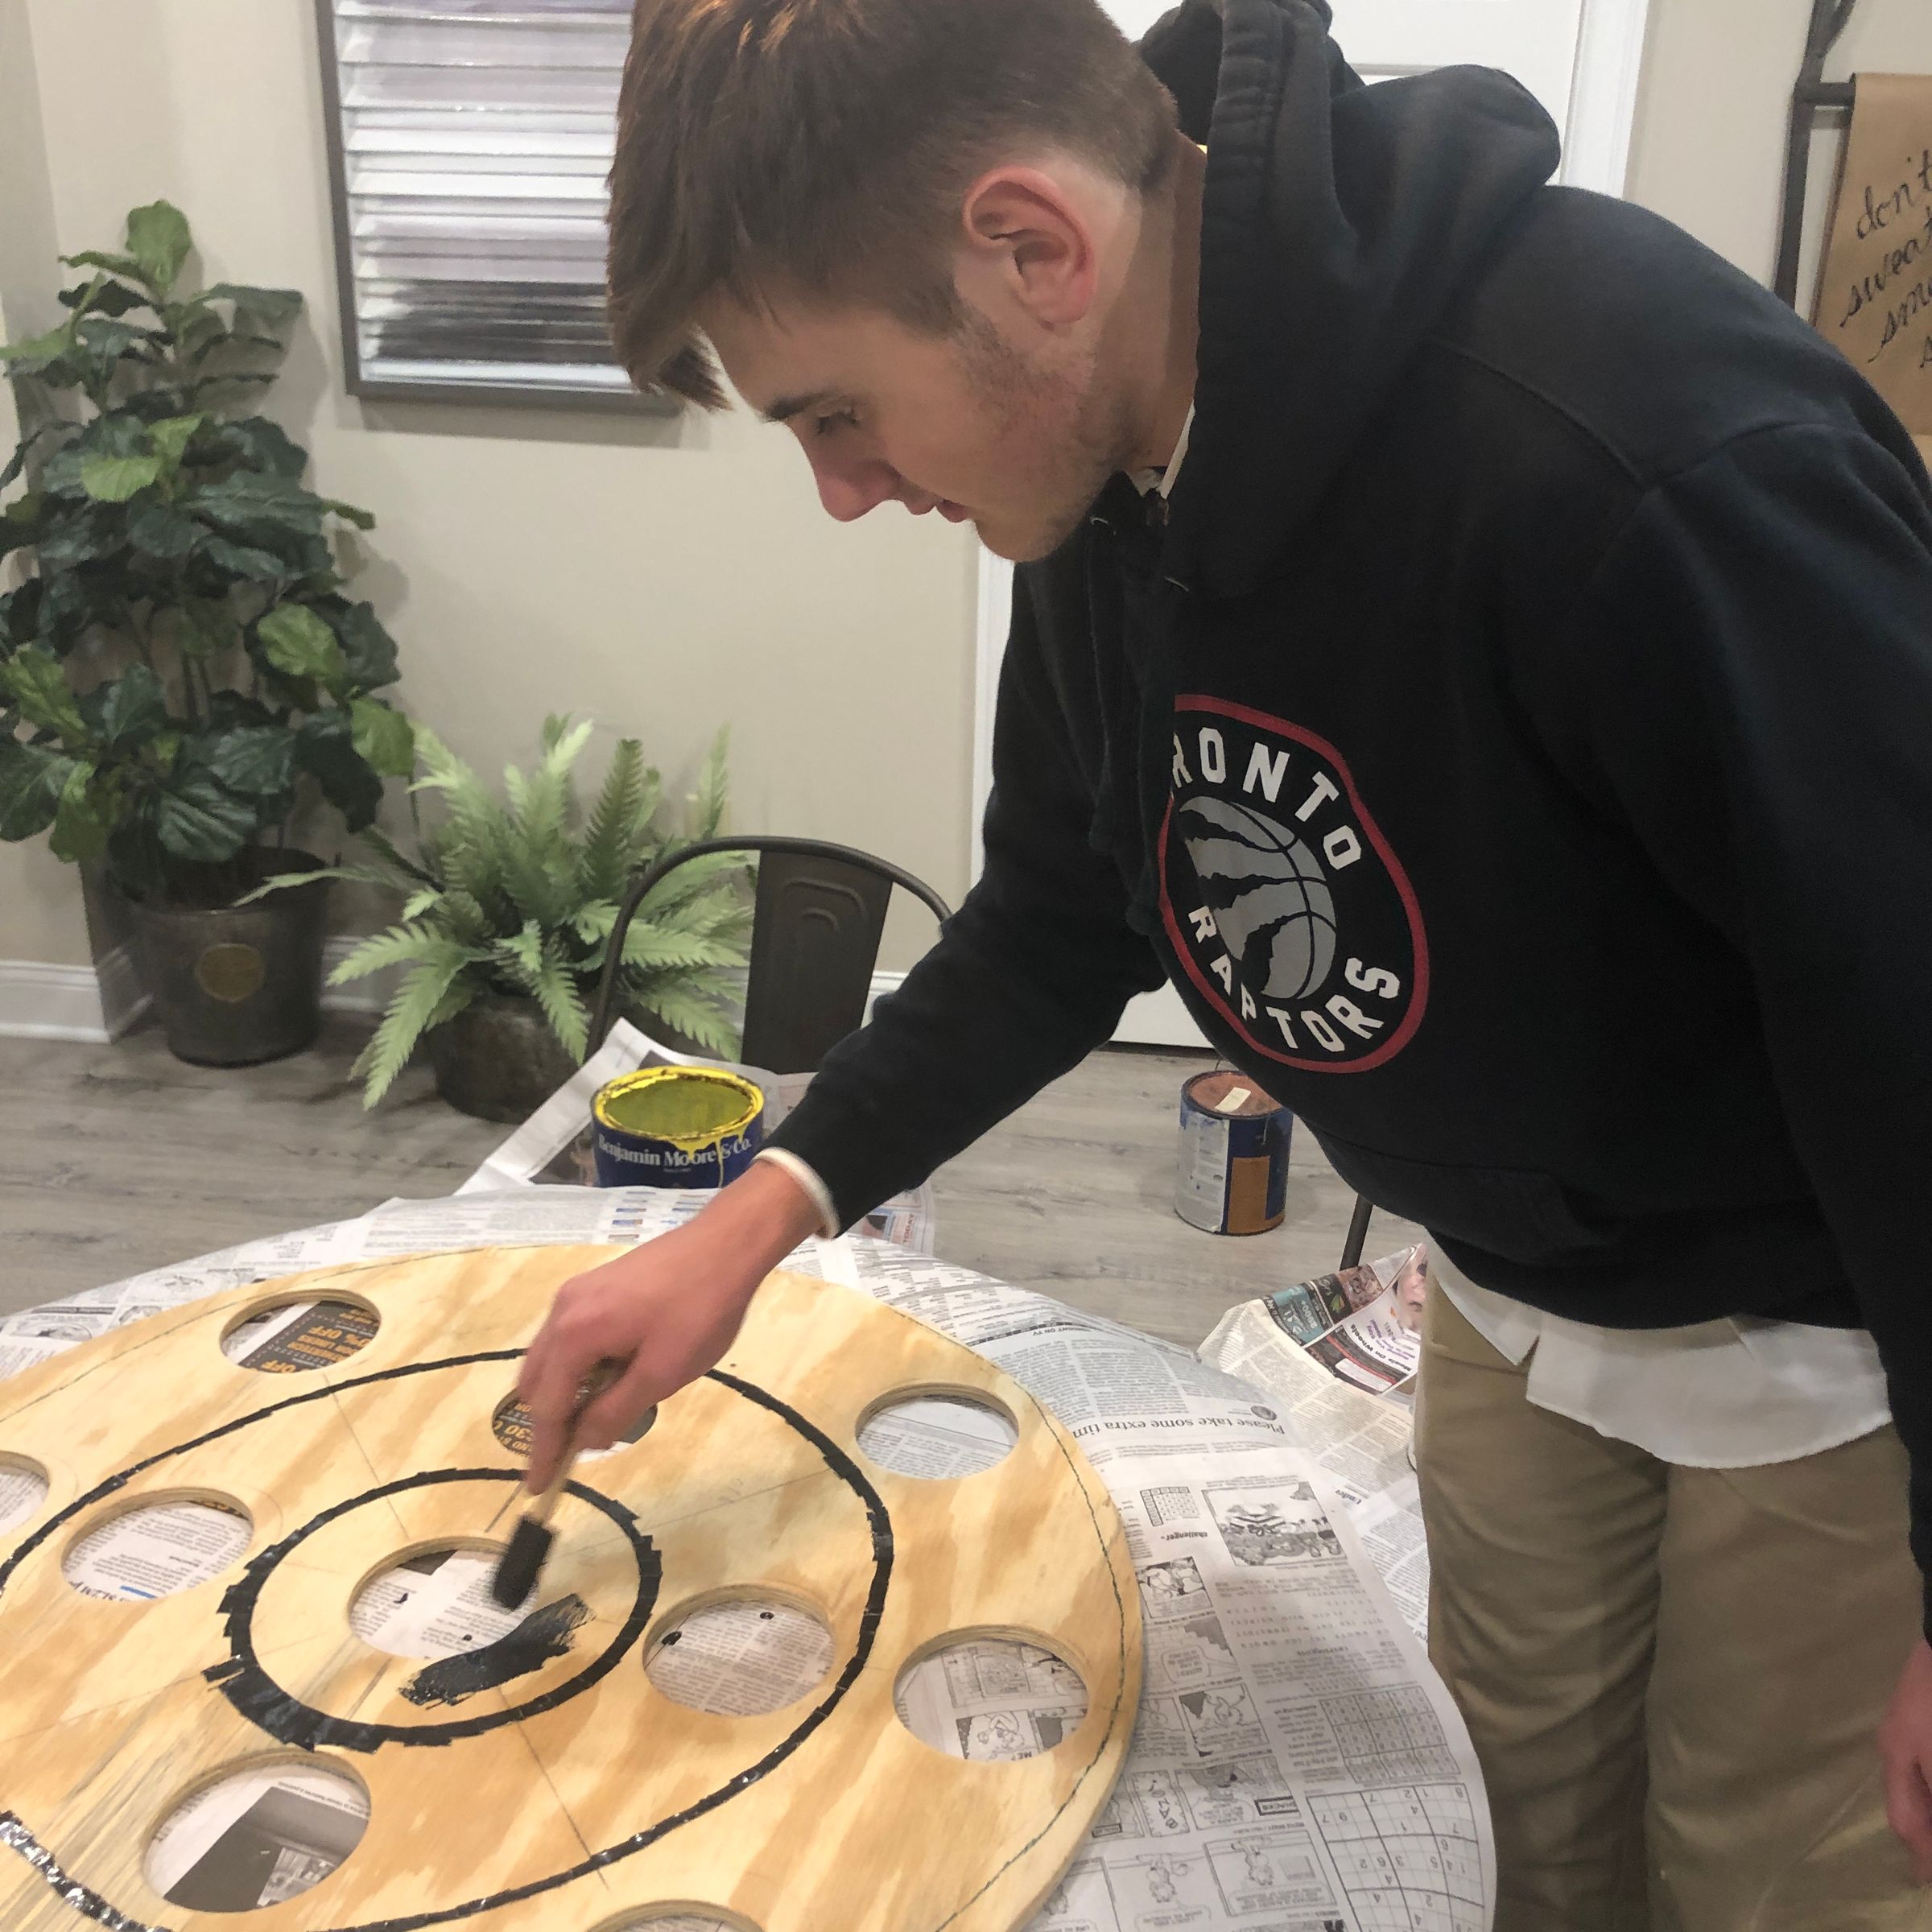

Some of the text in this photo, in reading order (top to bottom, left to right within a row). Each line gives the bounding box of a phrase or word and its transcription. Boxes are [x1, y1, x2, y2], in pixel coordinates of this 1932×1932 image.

[1188, 905, 1400, 1053] RAPTORS
[599, 1133, 661, 1166] Benjamin
[663, 1150, 716, 1167] Moore
[1104, 1419, 1146, 1431] extra
[1151, 1418, 1193, 1428] some
[1198, 1417, 1233, 1427] take
[1236, 1418, 1286, 1435] Please
